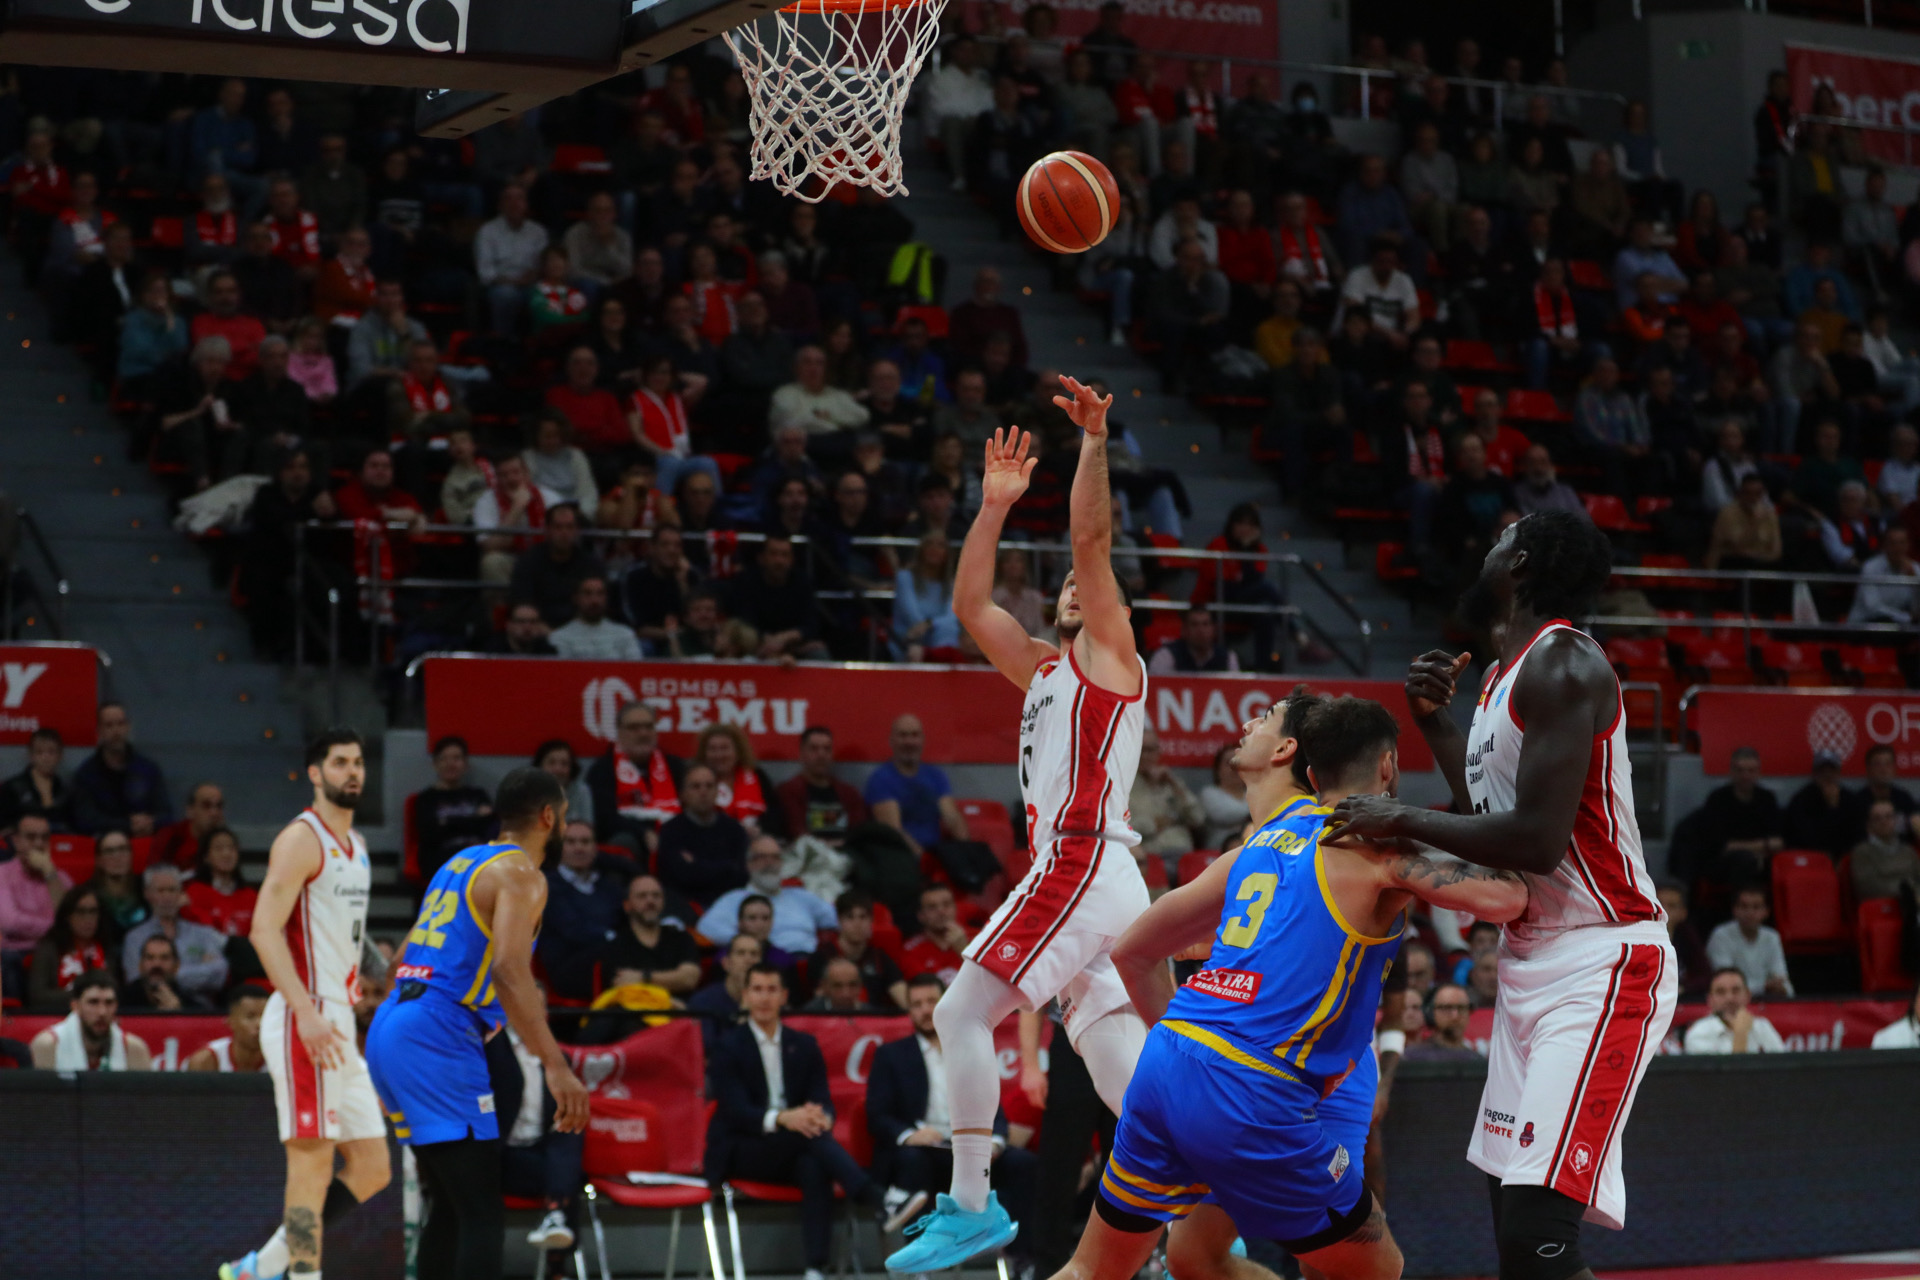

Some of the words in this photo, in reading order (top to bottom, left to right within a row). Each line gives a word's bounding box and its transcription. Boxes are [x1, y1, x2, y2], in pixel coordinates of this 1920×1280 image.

[84, 0, 471, 54] esa
[639, 677, 757, 698] BOMBAS
[409, 887, 460, 949] 22
[1220, 872, 1279, 949] 3
[1193, 981, 1252, 1001] assistance
